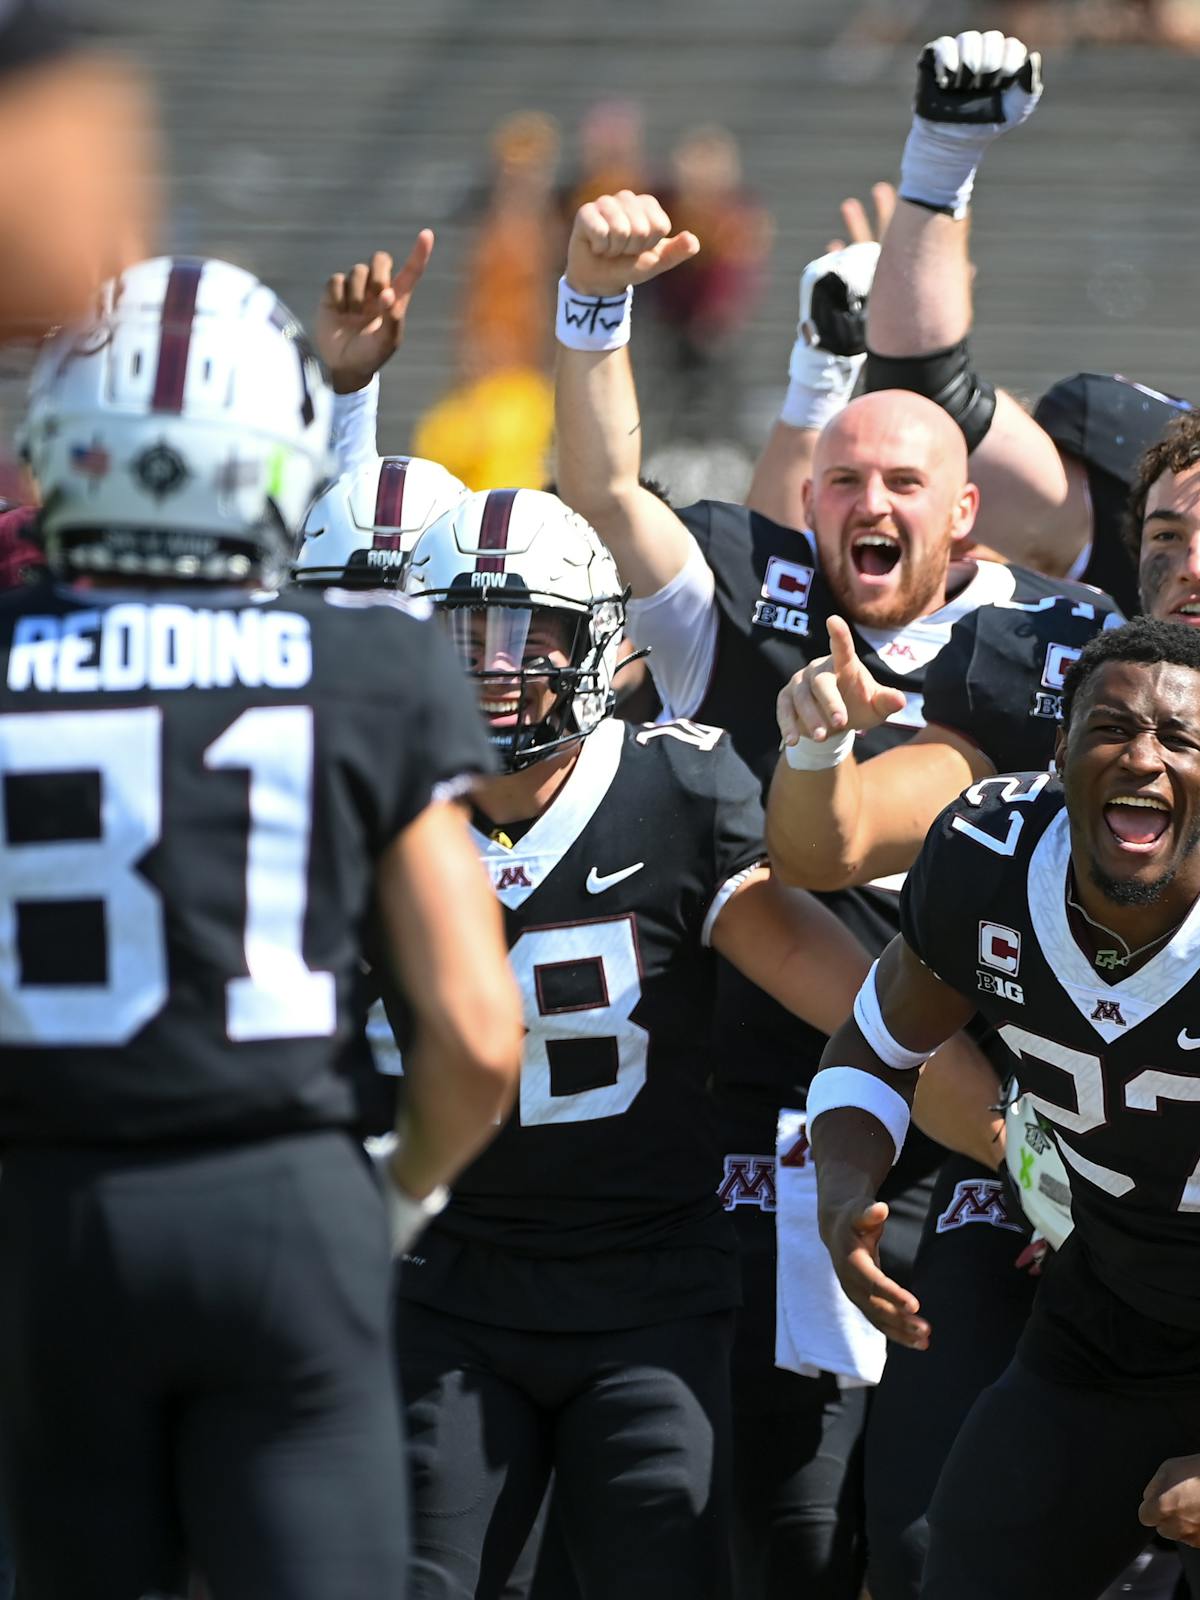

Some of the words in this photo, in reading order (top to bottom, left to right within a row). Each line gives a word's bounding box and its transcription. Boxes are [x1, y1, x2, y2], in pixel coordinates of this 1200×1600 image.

[367, 549, 403, 567] ROW
[470, 571, 508, 588] ROW
[7, 604, 313, 691] REDDING
[0, 704, 337, 1047] 81
[980, 924, 1020, 974] C
[506, 911, 651, 1128] 8
[1089, 998, 1128, 1028] M
